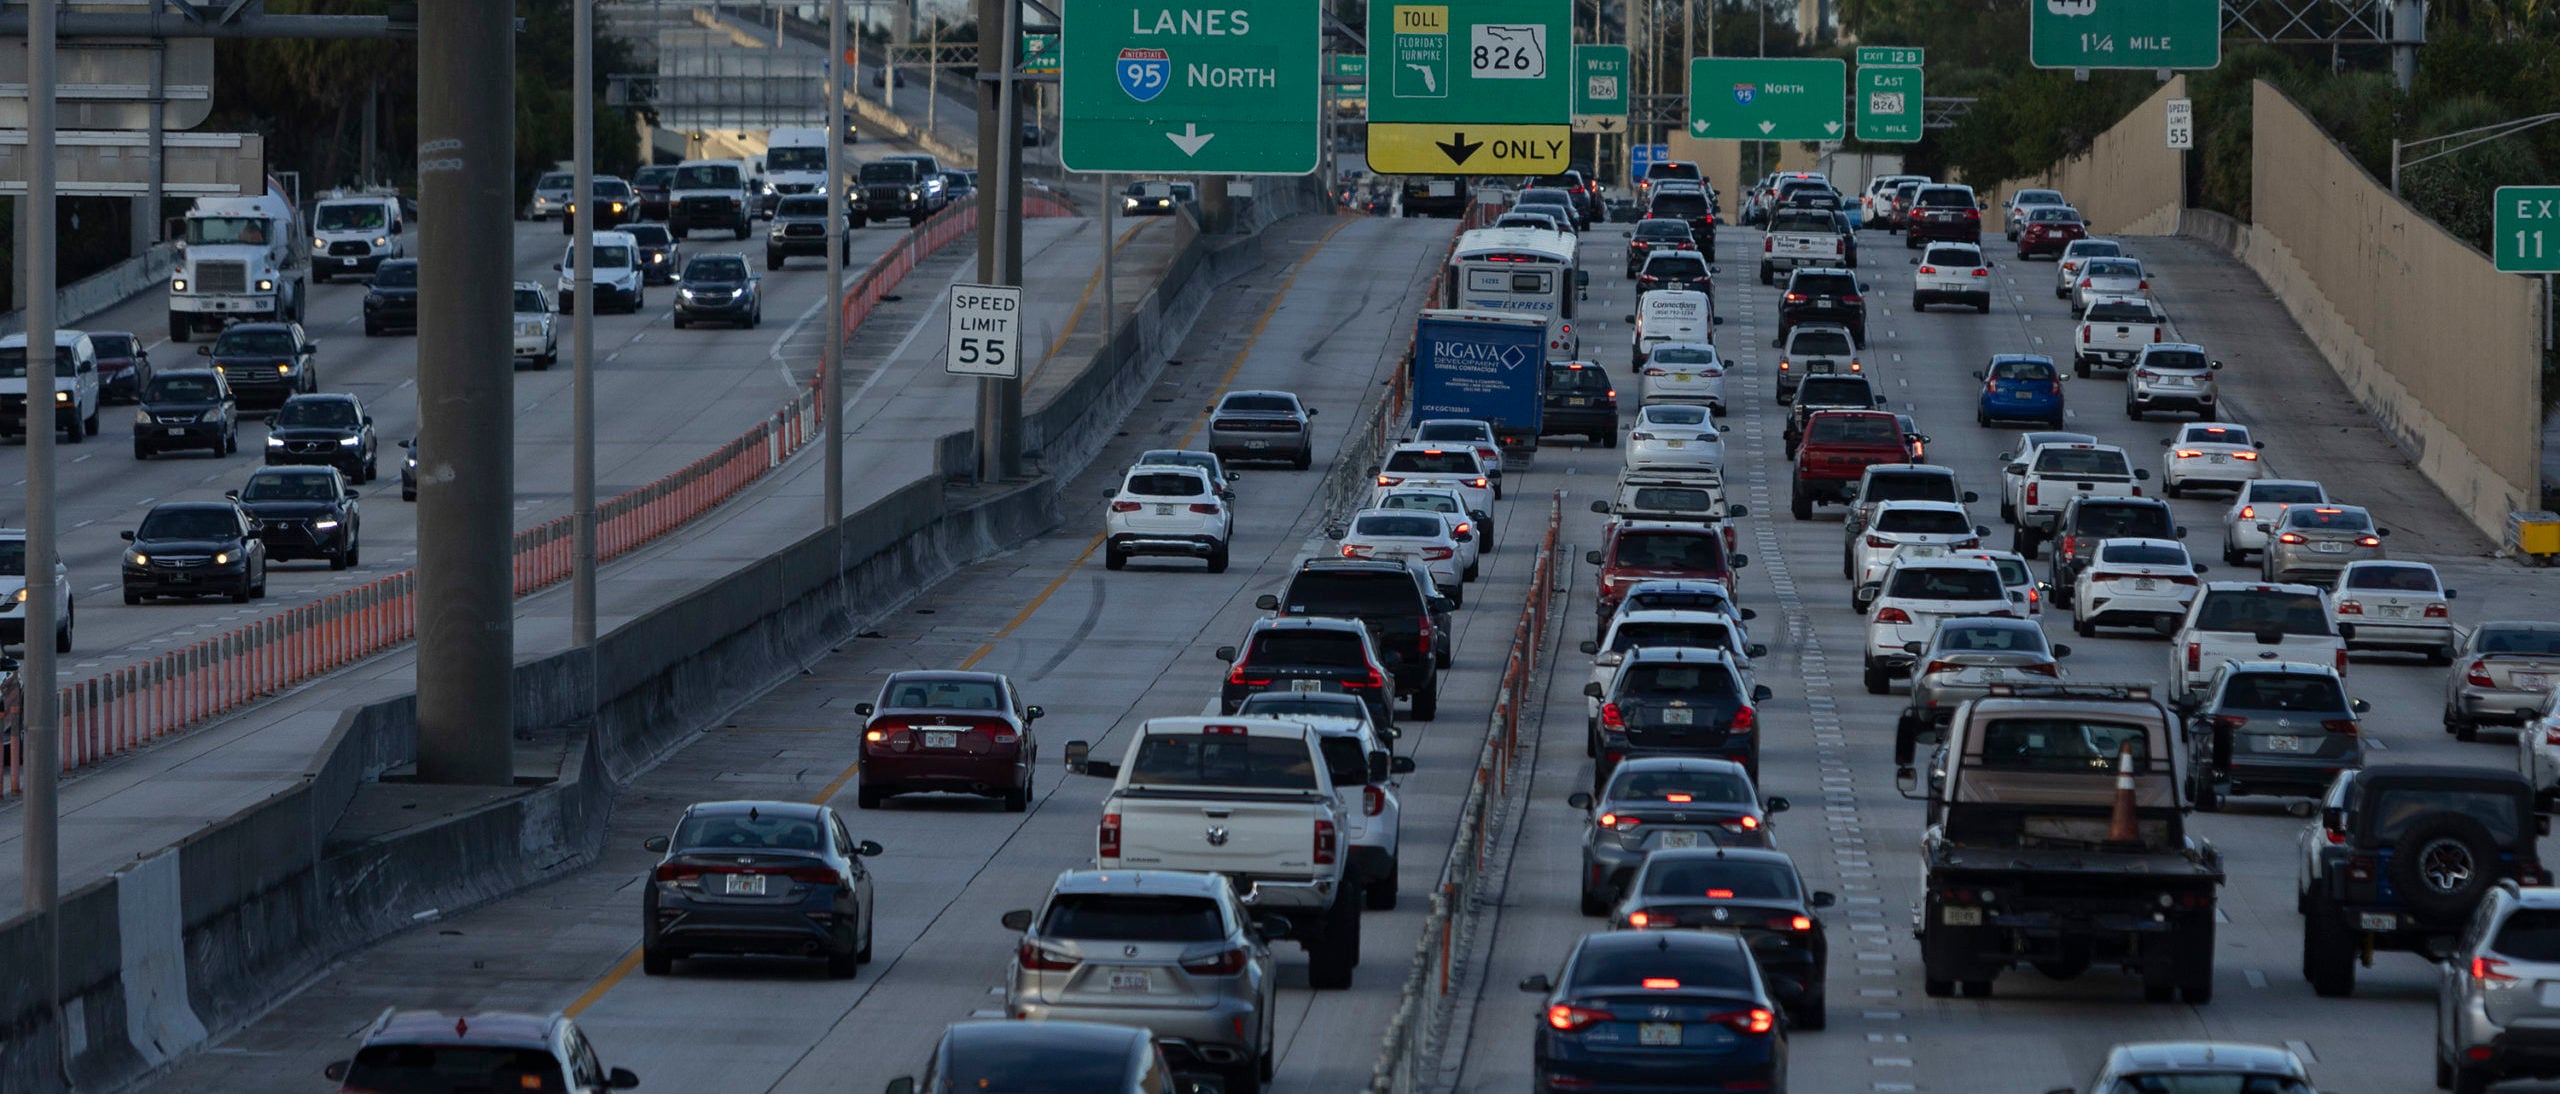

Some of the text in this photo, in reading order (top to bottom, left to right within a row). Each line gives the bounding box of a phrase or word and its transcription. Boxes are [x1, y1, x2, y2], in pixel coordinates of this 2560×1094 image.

[1133, 9, 1250, 35] LANES
[1403, 12, 1439, 27] TOLL
[1399, 37, 1443, 48] FLORIDA'S
[2130, 37, 2171, 50] MILE
[1124, 51, 1163, 59] INTERSTATE
[1401, 50, 1441, 61] TURNPIKE
[1473, 45, 1530, 70] 826
[1863, 51, 1916, 62] EXIT 12 B
[1127, 64, 1162, 88] 95
[1591, 85, 1612, 96] 826
[1737, 90, 1752, 100] 95
[1872, 101, 1895, 110] 826
[2168, 104, 2190, 113] SPEED
[2170, 117, 2188, 125] LIMIT
[1885, 125, 1907, 133] MILE
[2170, 129, 2188, 144] 55
[1492, 140, 1563, 160] ONLY
[956, 295, 1015, 311] SPEED
[1502, 301, 1554, 310] EXPRESS
[961, 317, 1007, 332] LIMIT
[959, 337, 1005, 366] 55
[1434, 341, 1500, 361] RIGAVA
[1434, 357, 1499, 368] DEVELOPMENT
